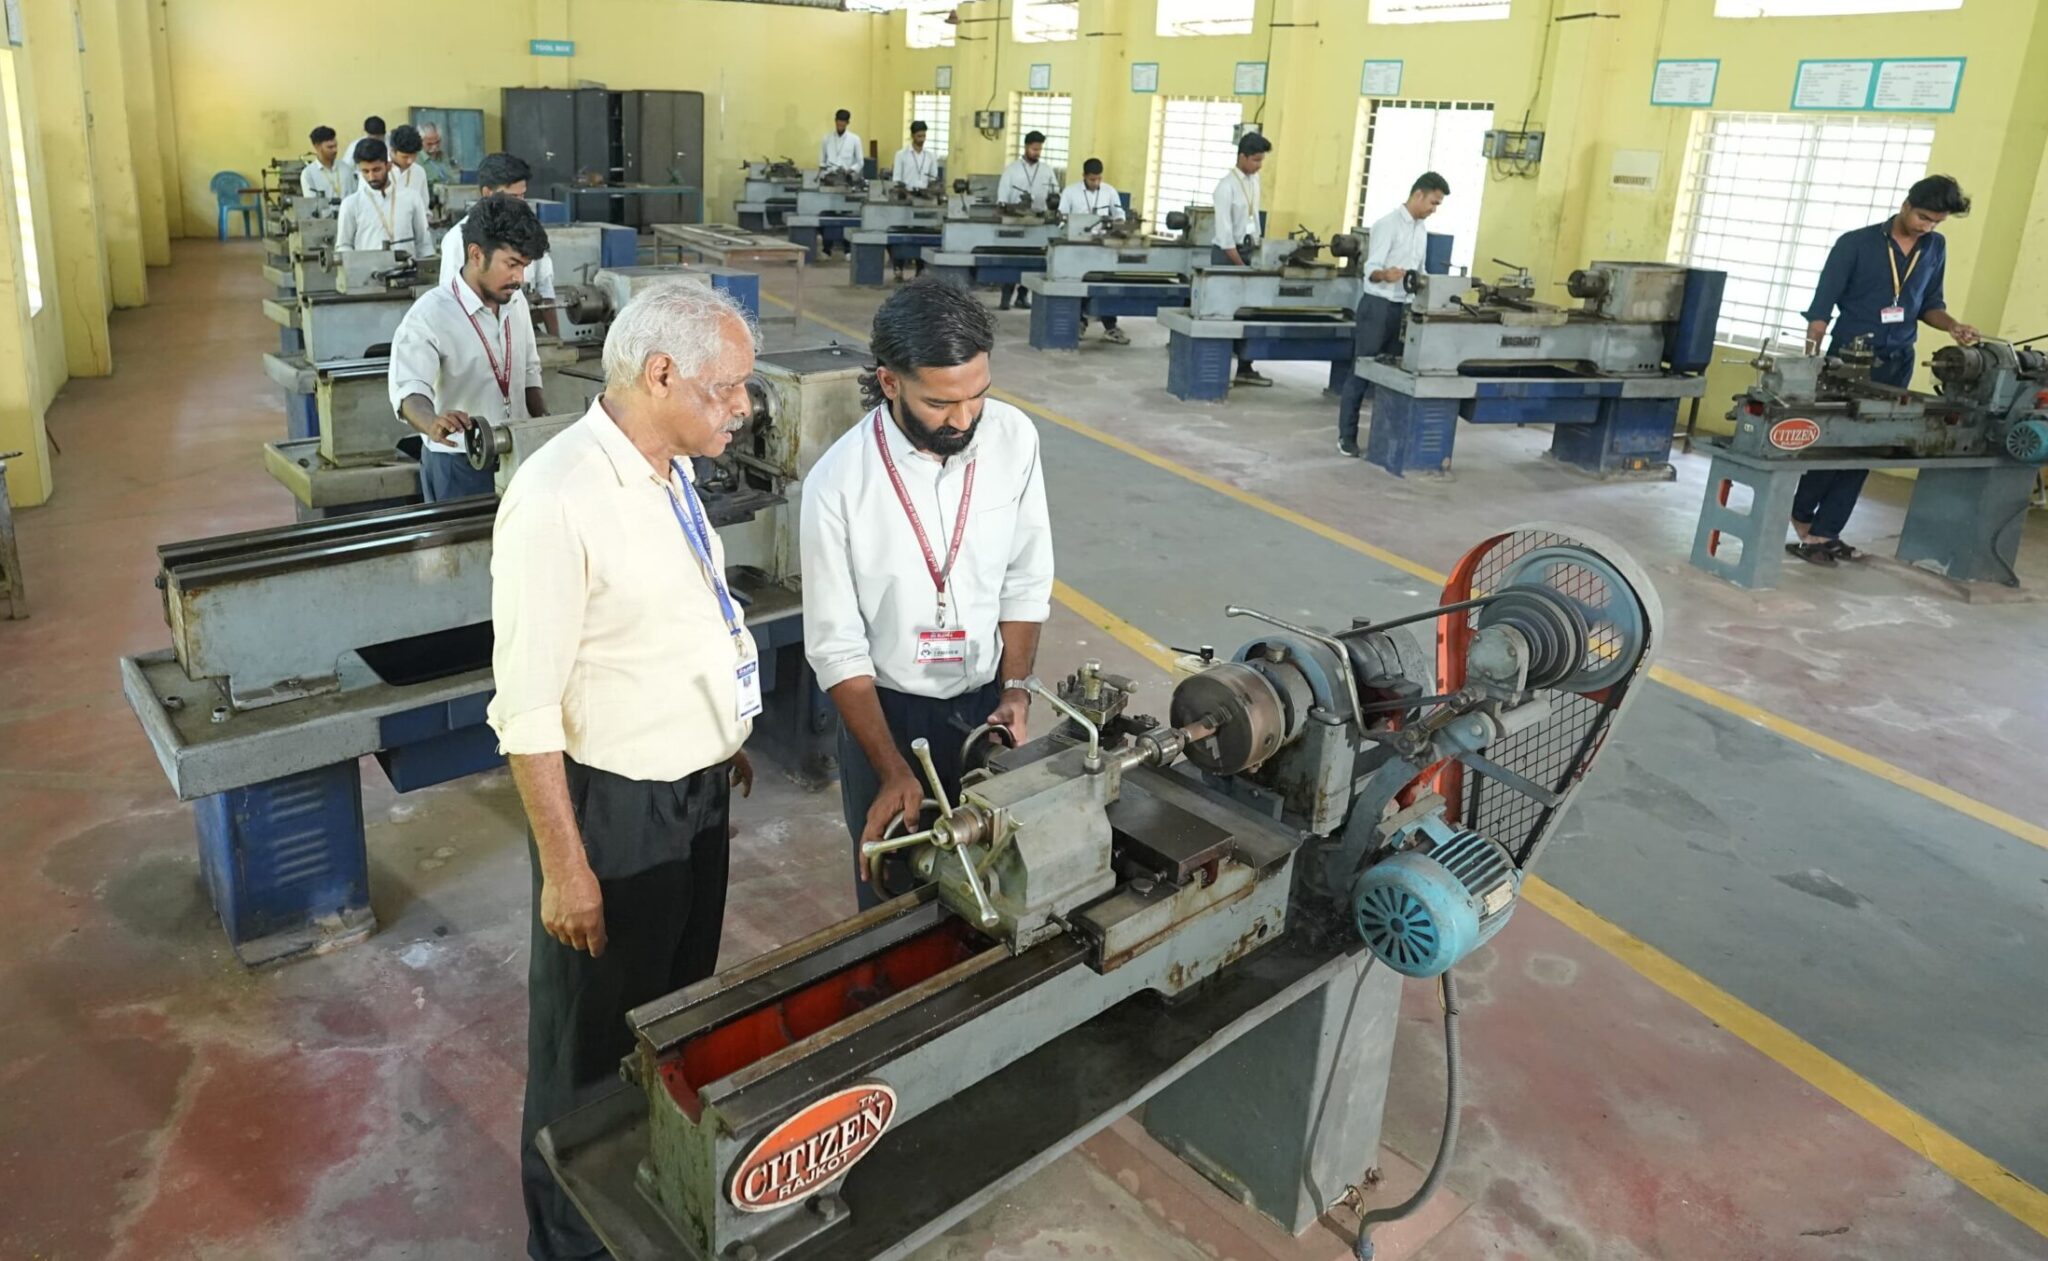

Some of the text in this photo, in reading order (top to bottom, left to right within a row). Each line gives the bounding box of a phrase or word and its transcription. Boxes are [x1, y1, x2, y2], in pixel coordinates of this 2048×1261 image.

[1773, 429, 1817, 442] CITIZEN
[859, 1091, 880, 1108] TM
[743, 1101, 886, 1202] CITIZEN
[778, 1149, 852, 1200] RAJKOT
